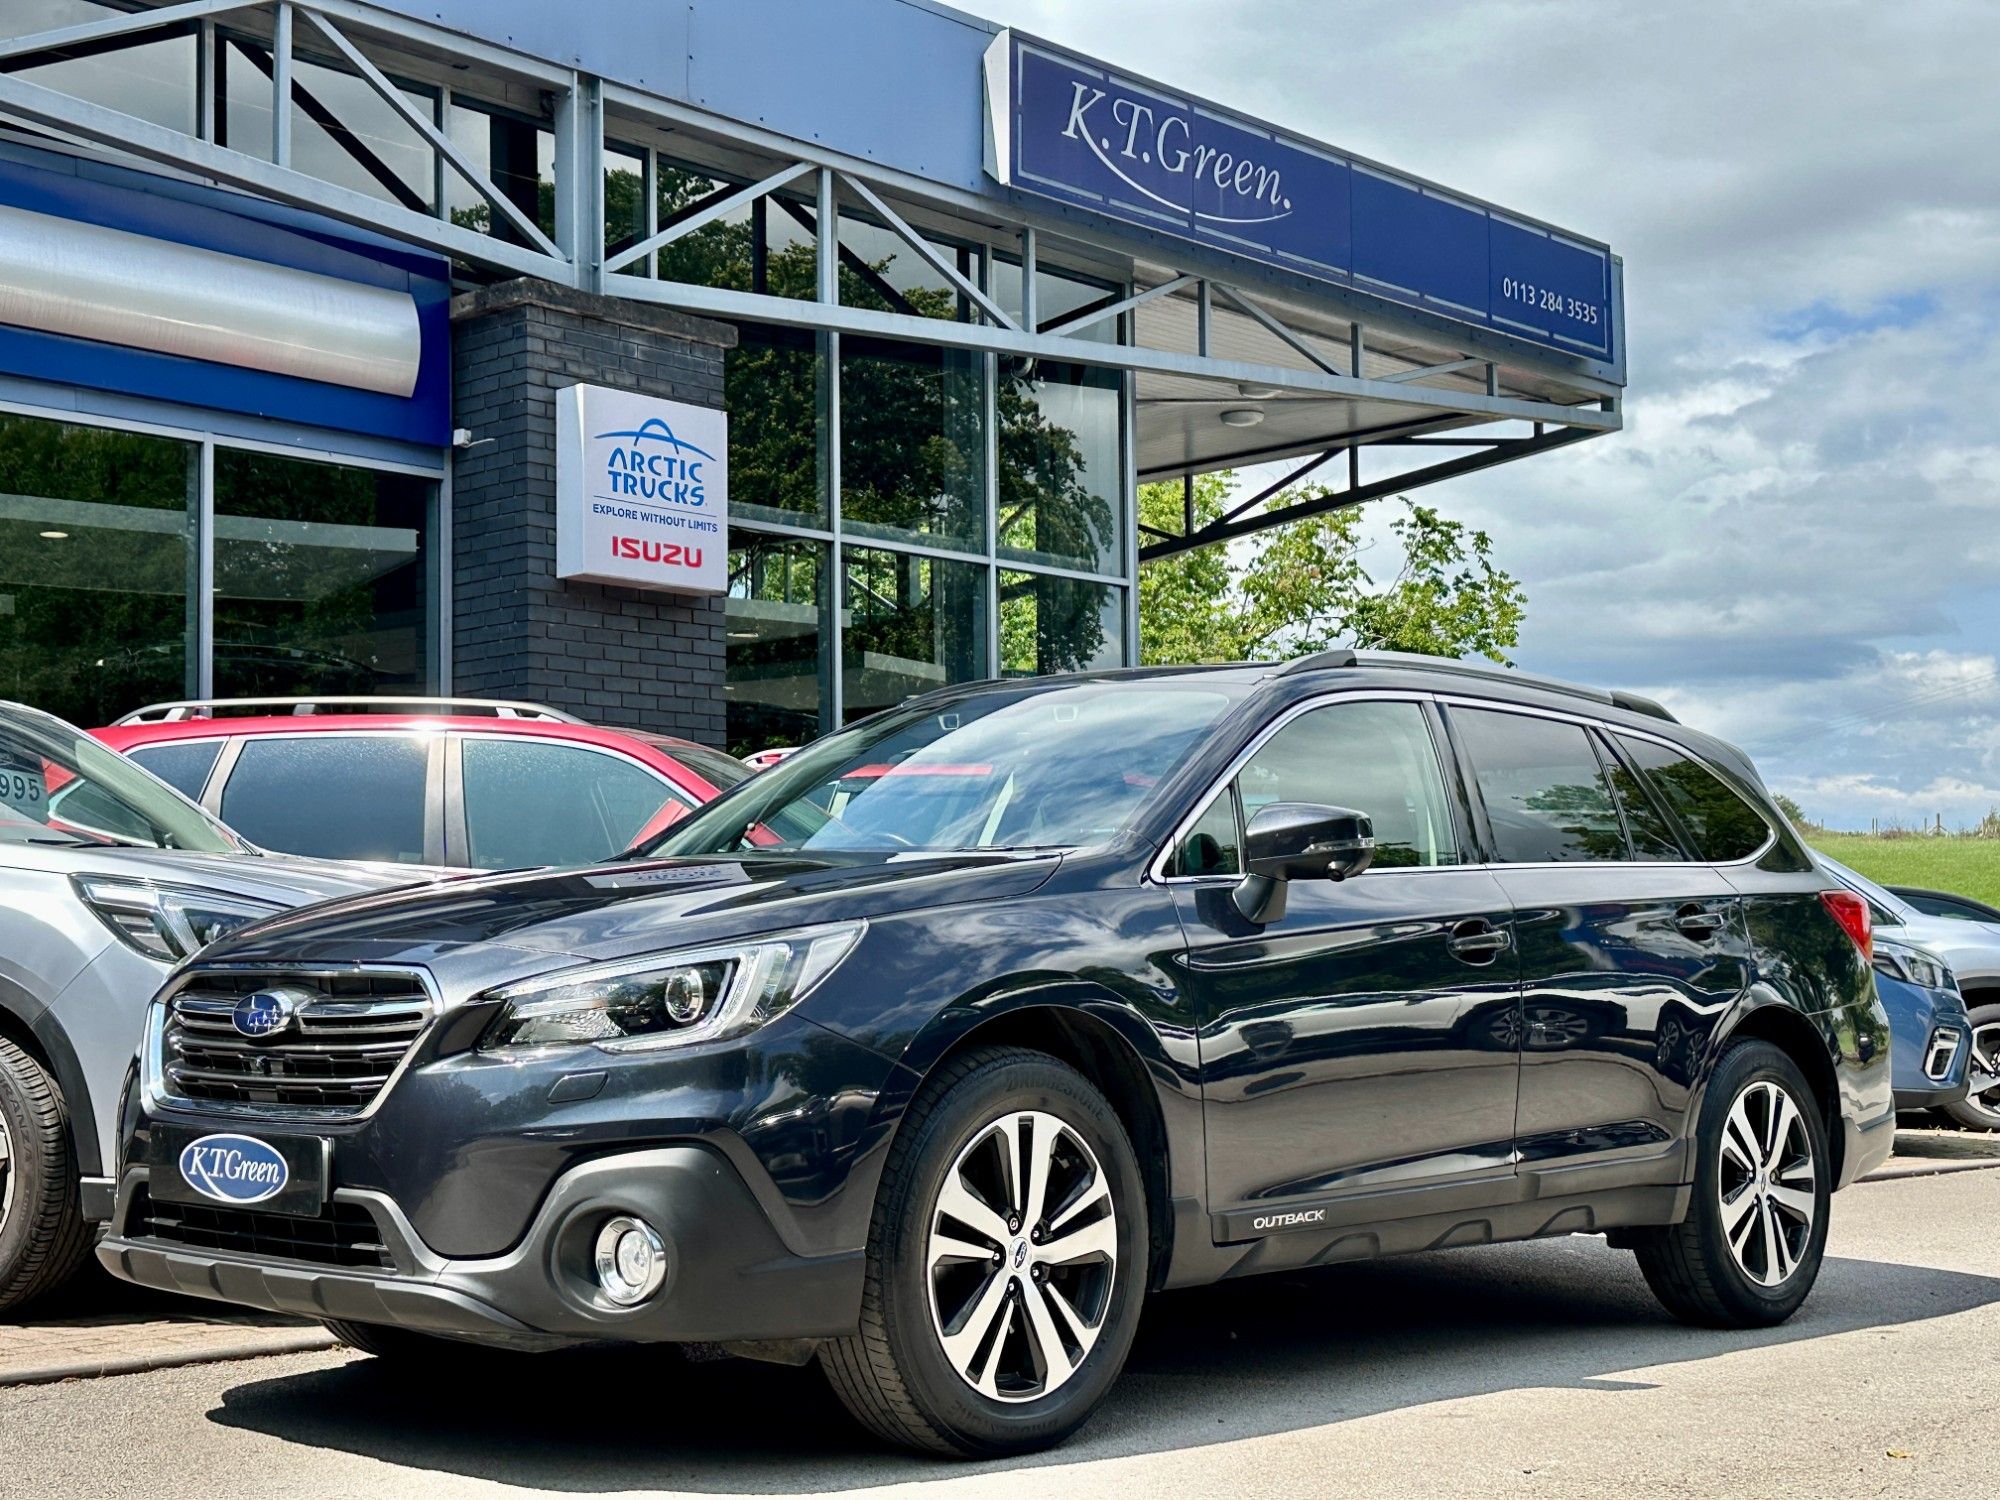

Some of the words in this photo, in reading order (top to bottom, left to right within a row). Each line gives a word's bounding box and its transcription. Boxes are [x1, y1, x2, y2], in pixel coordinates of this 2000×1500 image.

[1503, 277, 1535, 305] 0113
[1540, 289, 1563, 314] 284
[1567, 298, 1597, 324] 3535
[608, 447, 702, 483] ARCTIC
[608, 470, 705, 507] TRUCKS
[592, 503, 638, 520] EXPLORE
[640, 511, 686, 528] WITHOUT
[688, 519, 718, 533] LIMITS
[612, 536, 702, 568] ISUZU
[1253, 1209, 1326, 1230] OUTBACK
